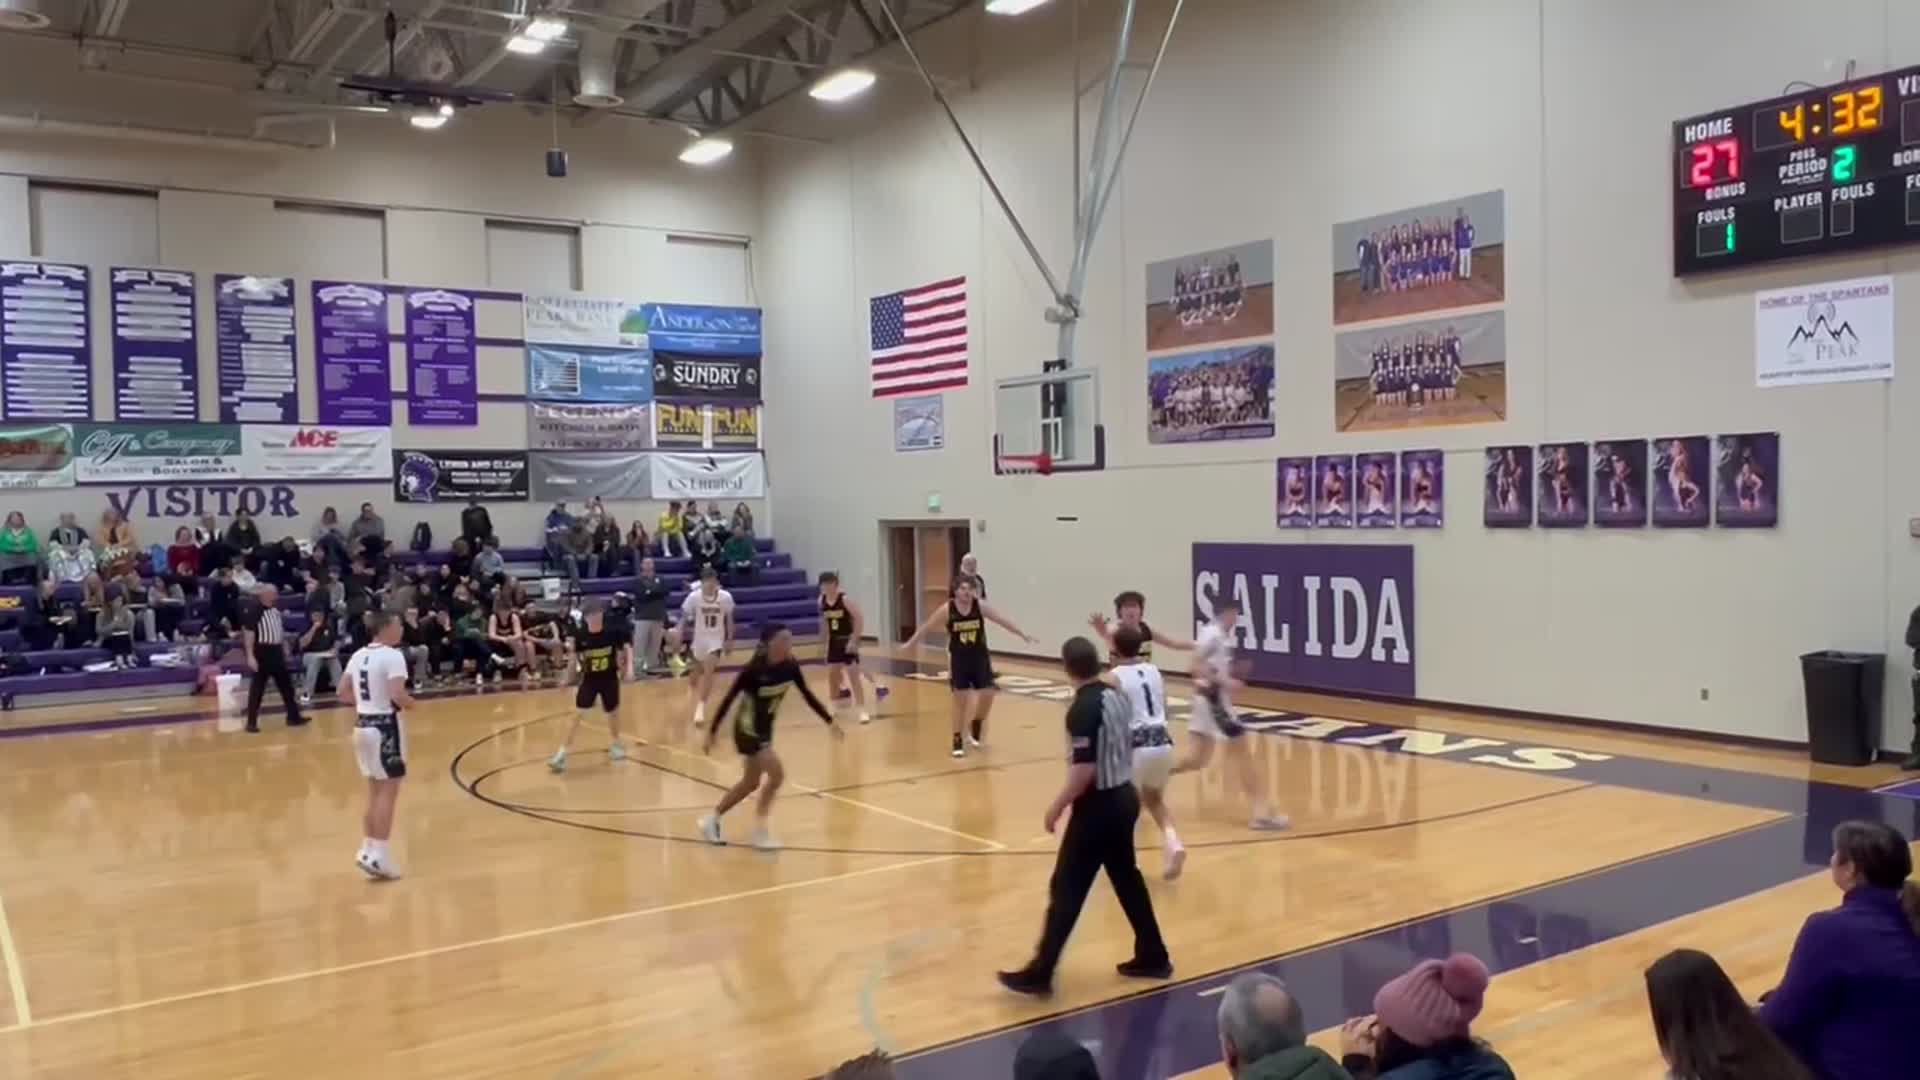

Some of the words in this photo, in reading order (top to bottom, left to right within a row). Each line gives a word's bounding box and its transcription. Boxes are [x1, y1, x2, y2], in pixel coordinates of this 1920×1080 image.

[1898, 74, 1920, 96] VI
[1779, 88, 1882, 143] 4:32
[1685, 117, 1733, 143] HOME
[1691, 140, 1739, 186] 27
[1779, 158, 1827, 179] PERIOD
[1833, 146, 1855, 182] 2
[1705, 181, 1746, 201] BONUS
[1774, 191, 1822, 212] PLAYER
[1831, 182, 1875, 202] FOULS
[1698, 206, 1735, 225] FOULS
[1726, 222, 1736, 254] 1
[673, 364, 740, 385] SUNDRY
[657, 403, 705, 433] FUN
[713, 406, 756, 435] FUN
[289, 428, 340, 448] ACE
[106, 486, 299, 521] VISITOR
[1195, 569, 1410, 664] SALIDA
